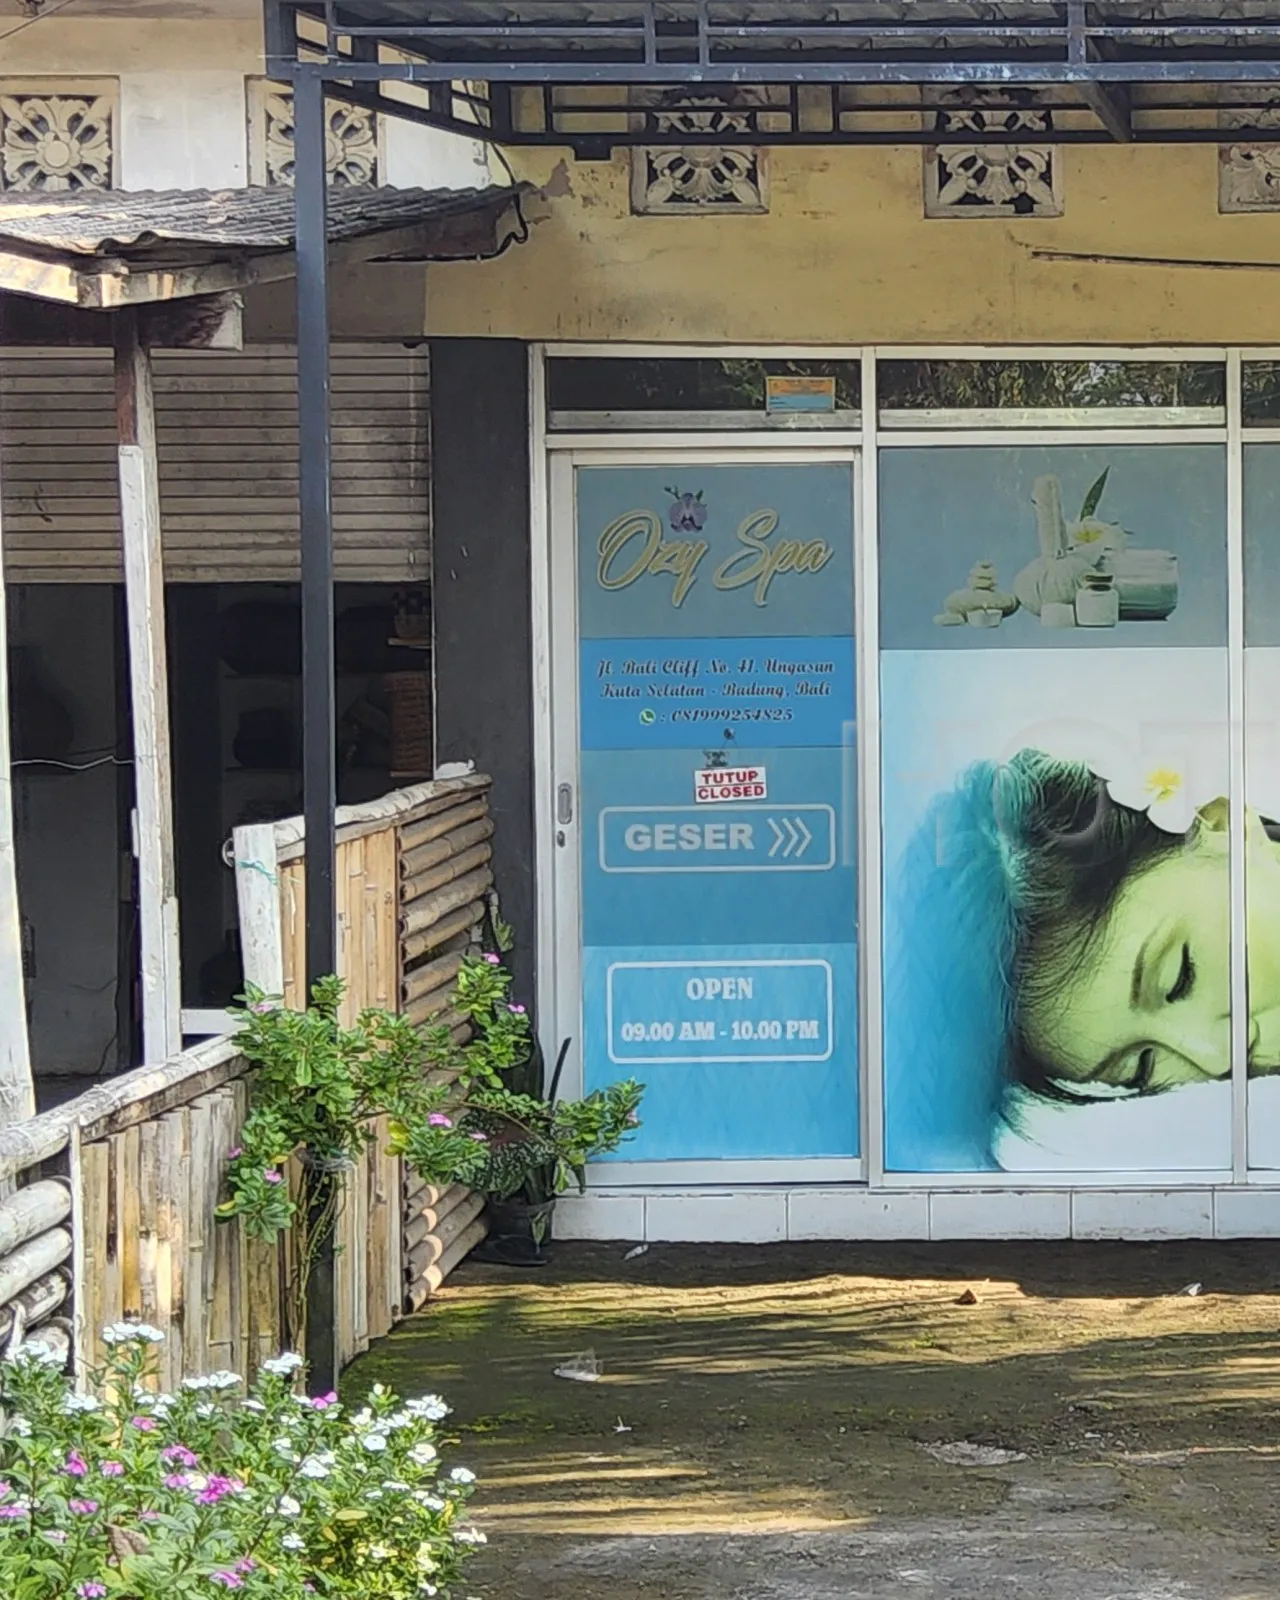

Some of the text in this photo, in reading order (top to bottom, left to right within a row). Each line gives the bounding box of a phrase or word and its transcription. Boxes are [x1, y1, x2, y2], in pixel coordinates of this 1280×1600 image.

[597, 508, 834, 608] Ozy Spa
[621, 659, 657, 675] Bali
[662, 659, 699, 679] Cliff
[705, 658, 732, 675] No.
[763, 658, 834, 676] Ungasan
[600, 683, 641, 698] Kuta
[646, 682, 705, 698] Selatan
[794, 681, 831, 697] Bali
[701, 770, 759, 785] TUTUP
[698, 785, 764, 800] CLOSED
[624, 822, 755, 851] GESER
[686, 977, 754, 1001] OPEN
[621, 1022, 674, 1042] 09.00
[678, 1021, 715, 1041] AM
[731, 1020, 783, 1041] 10.00
[786, 1020, 819, 1040] PM
